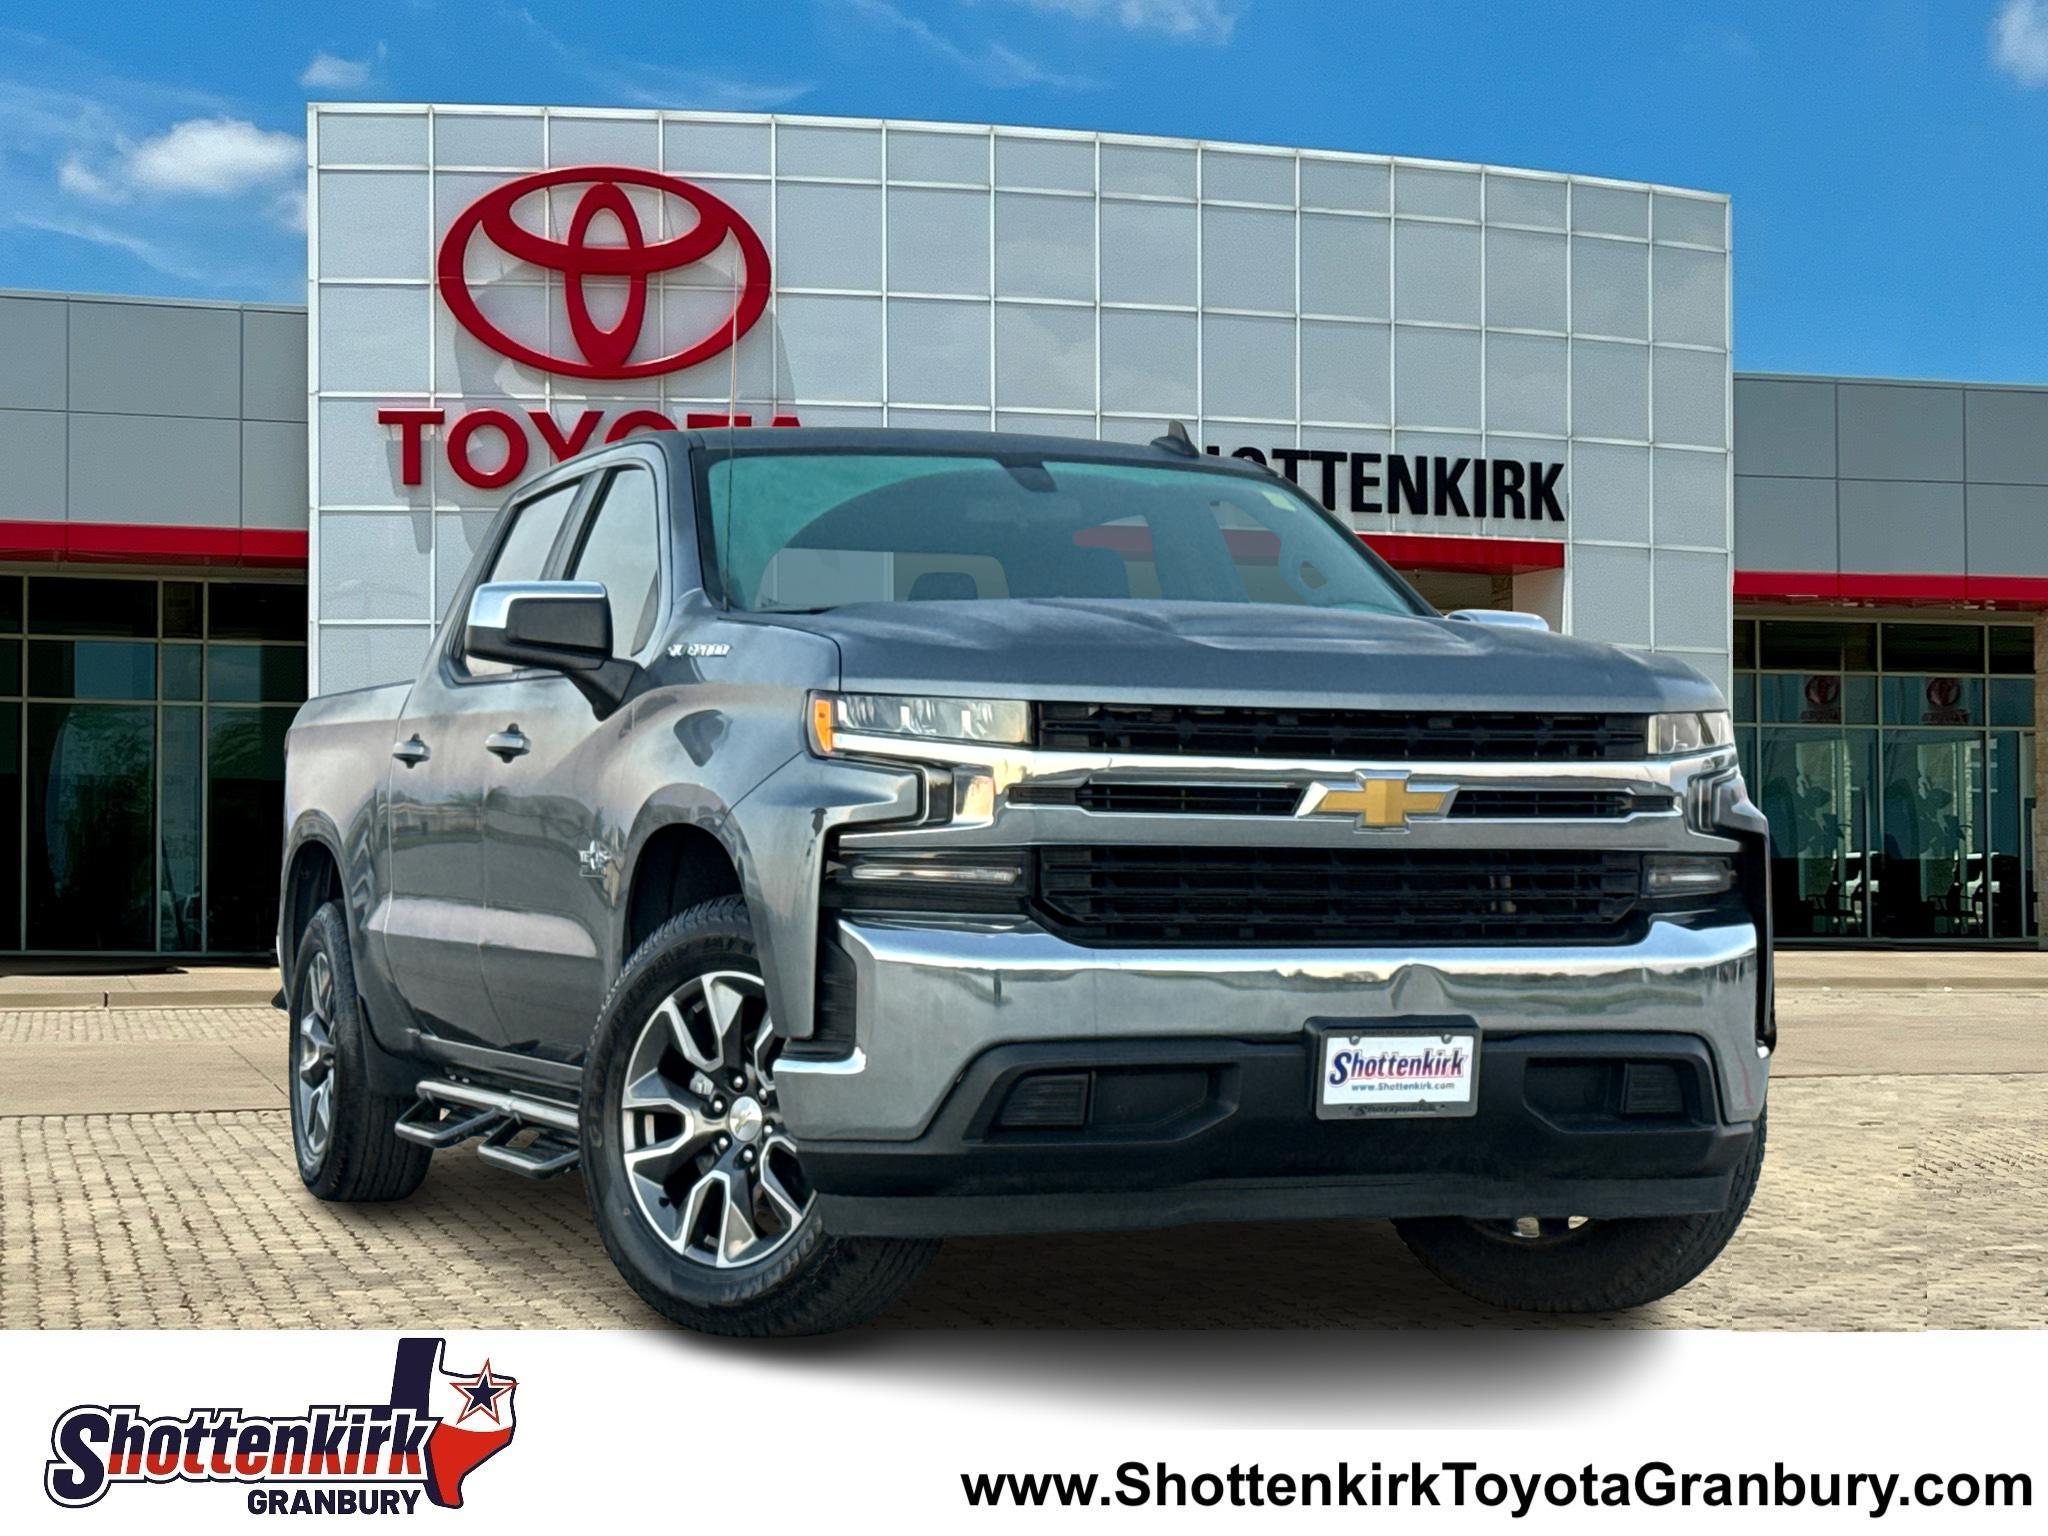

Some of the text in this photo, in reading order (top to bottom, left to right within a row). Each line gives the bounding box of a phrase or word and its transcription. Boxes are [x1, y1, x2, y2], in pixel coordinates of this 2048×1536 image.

[378, 407, 801, 489] TOY
[1330, 1048, 1466, 1085] Shottenkirk
[1351, 1081, 1455, 1092] www.Shottenkirk.com
